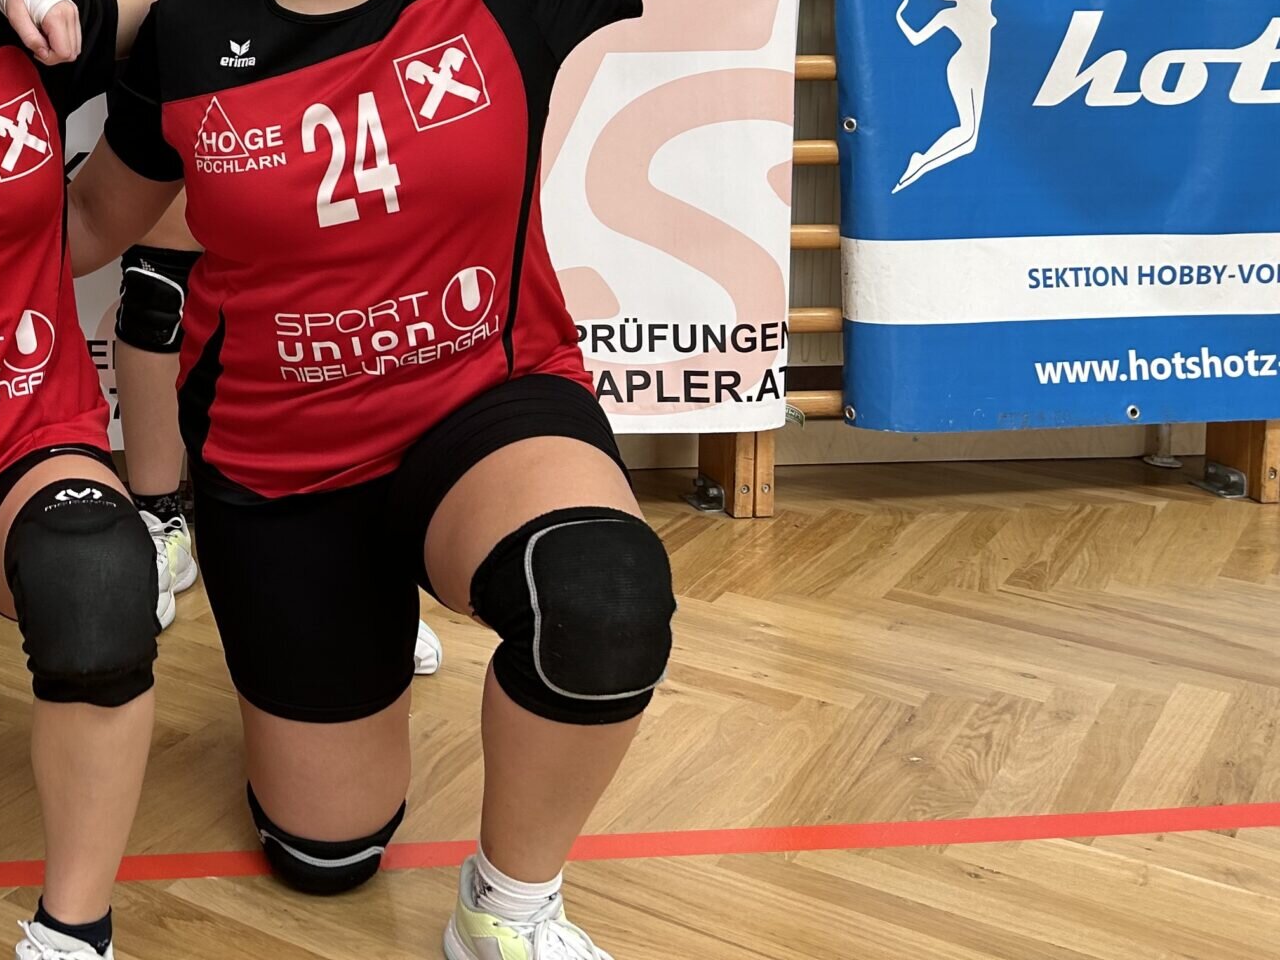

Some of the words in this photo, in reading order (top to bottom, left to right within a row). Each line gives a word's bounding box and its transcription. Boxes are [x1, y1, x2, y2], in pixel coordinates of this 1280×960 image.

[220, 55, 256, 68] erima
[196, 152, 287, 174] PÖCHLARN
[301, 90, 402, 229] 24
[1028, 266, 1128, 289] SEKTION
[1138, 263, 1280, 286] HOBBY-VO
[274, 290, 429, 337] SPORT
[277, 321, 435, 362] union
[280, 314, 500, 384] NIBELUNGENGAU
